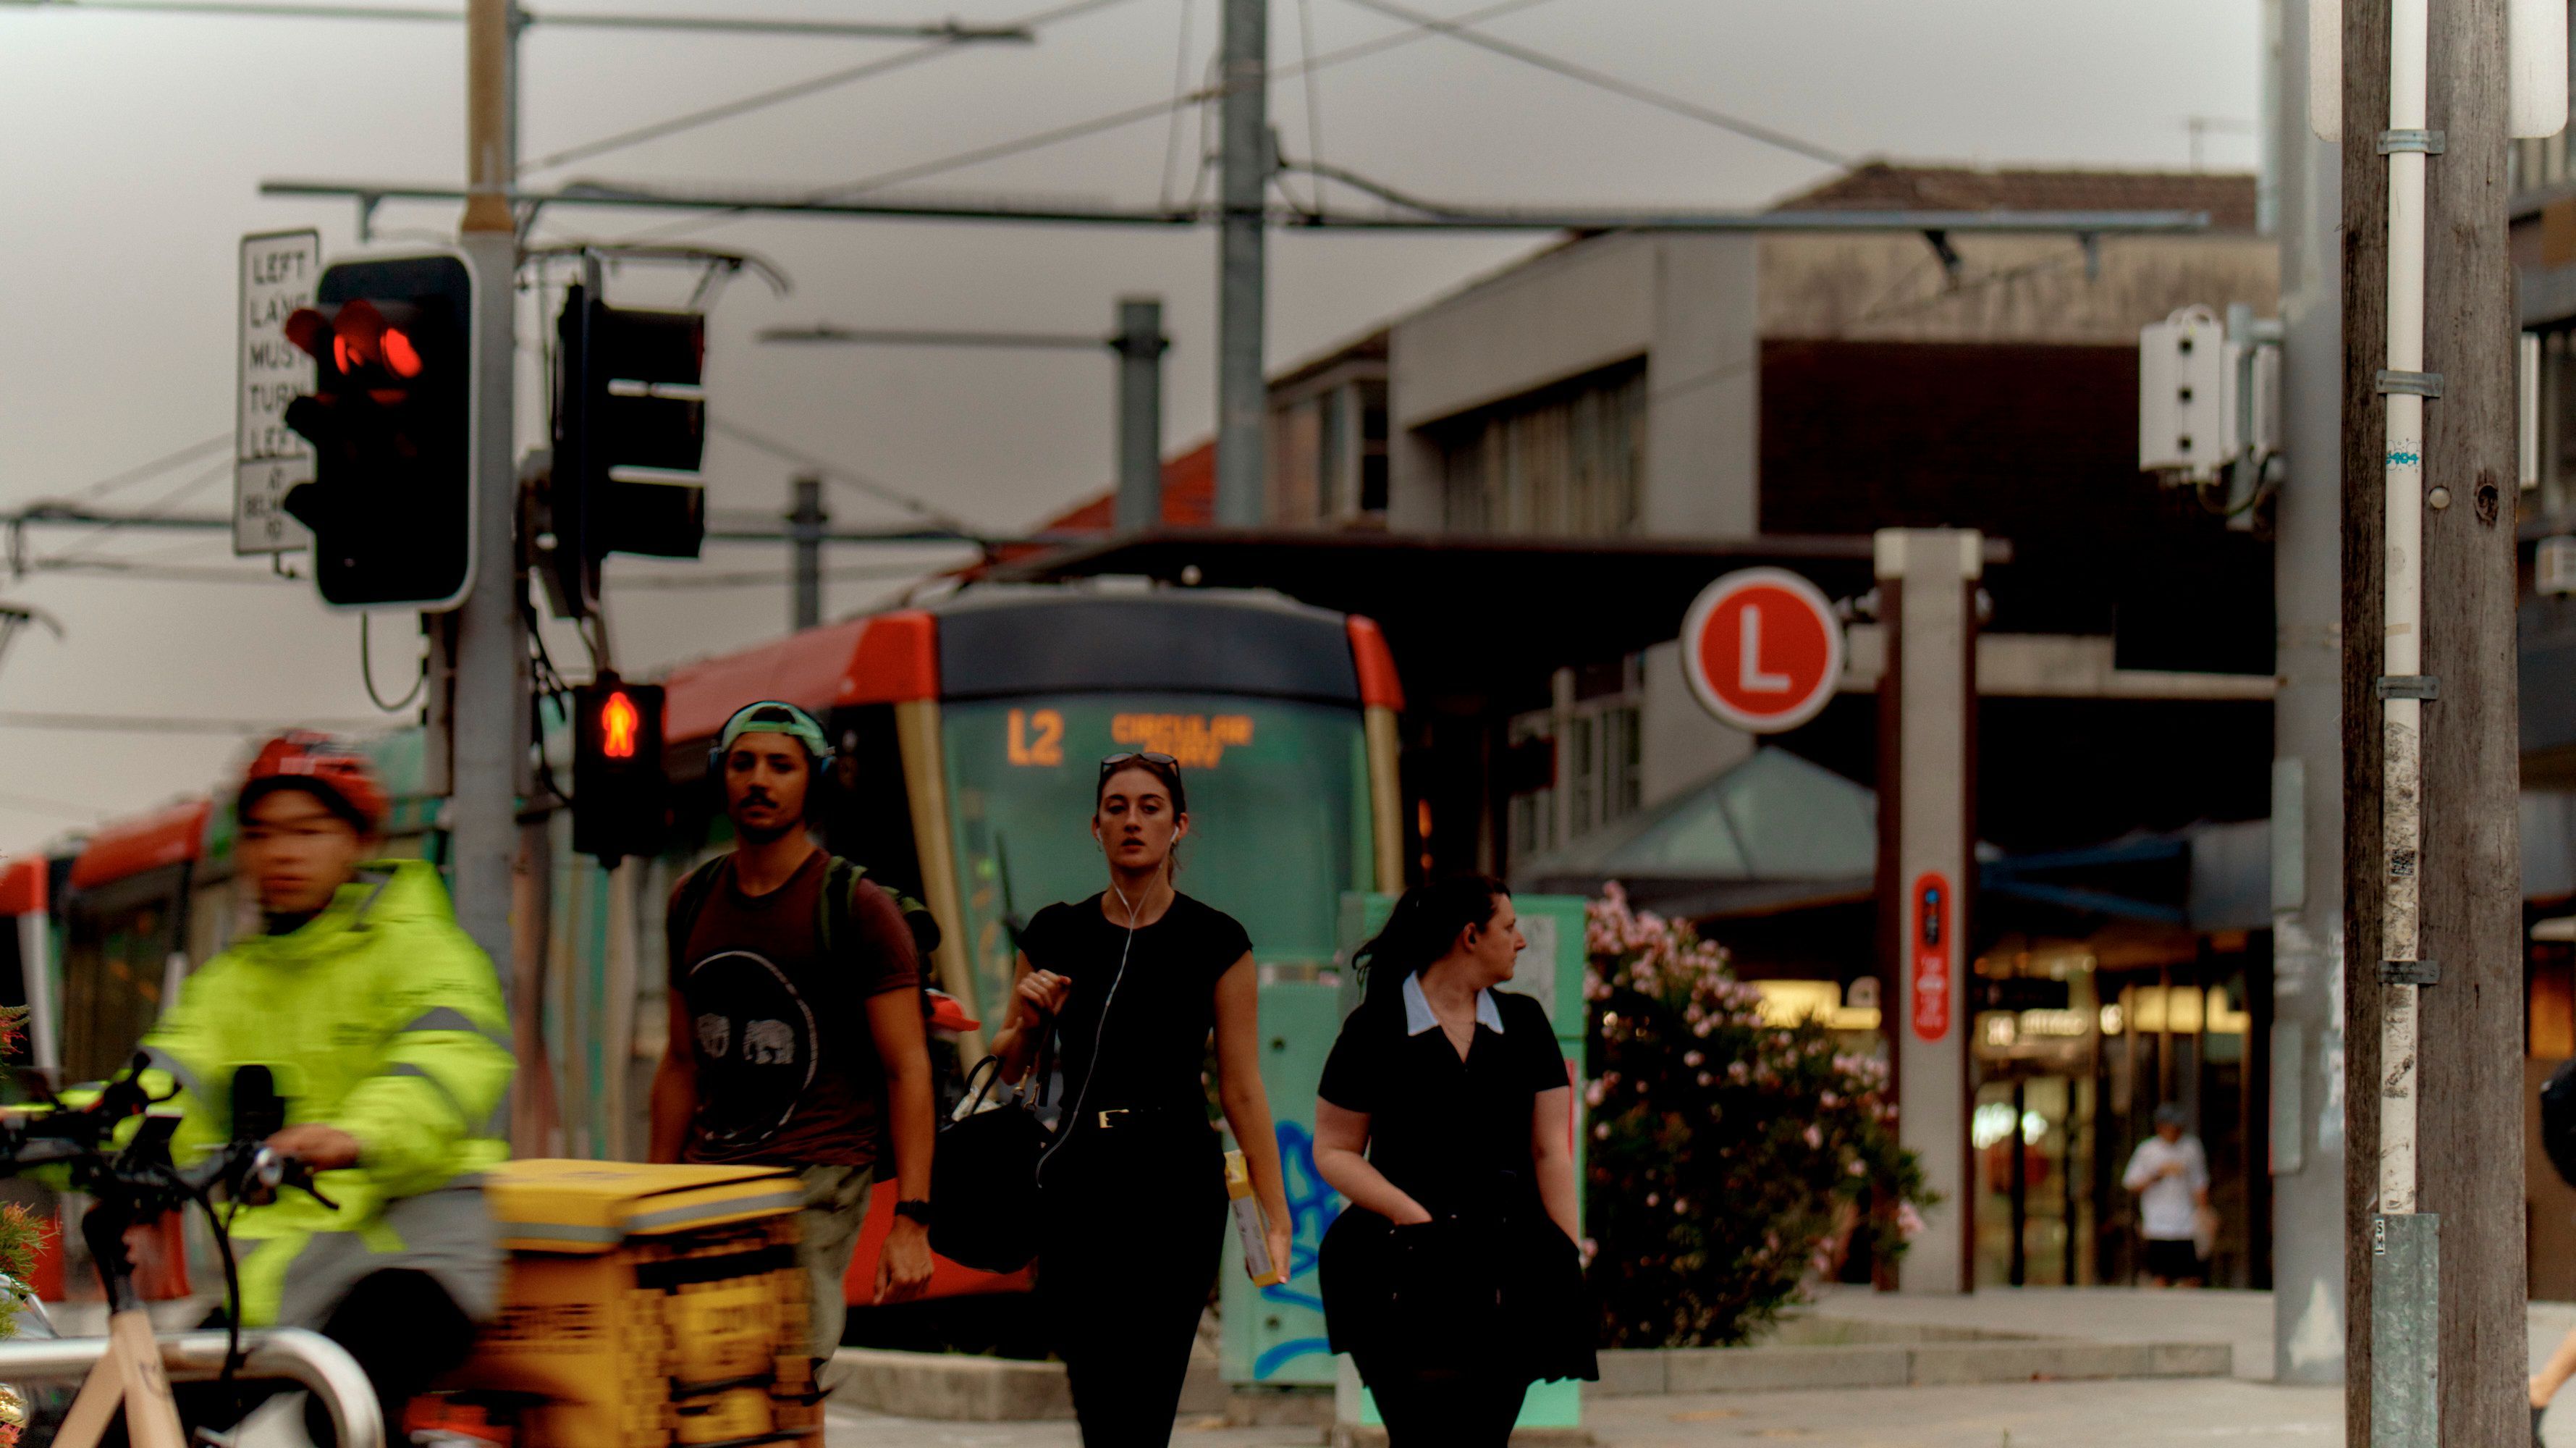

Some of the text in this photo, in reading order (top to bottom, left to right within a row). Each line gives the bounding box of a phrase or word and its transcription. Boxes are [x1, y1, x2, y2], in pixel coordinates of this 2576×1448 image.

[253, 251, 305, 285] LEFT
[250, 292, 308, 328] LAN
[1739, 604, 1792, 693] L
[1007, 708, 1065, 766] L2
